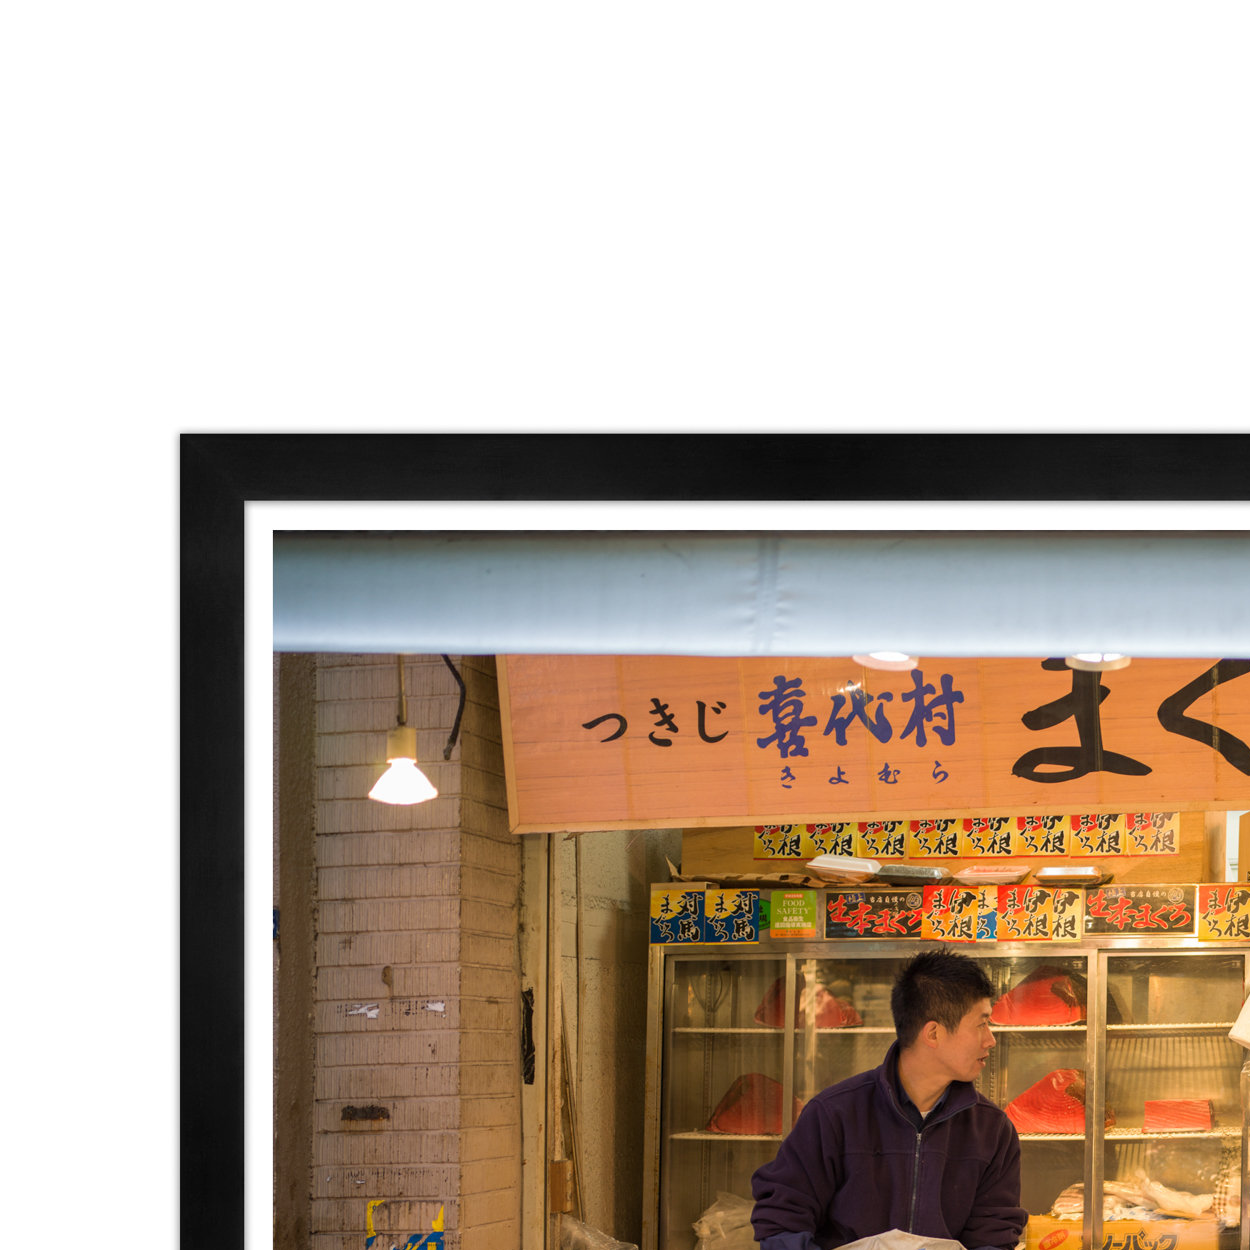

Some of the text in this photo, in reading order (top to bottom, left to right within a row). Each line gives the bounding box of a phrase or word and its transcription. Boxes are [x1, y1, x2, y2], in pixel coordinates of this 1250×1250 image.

[580, 697, 730, 748] つきじ
[756, 669, 965, 759] 喜代村
[779, 760, 950, 789] きよむら
[653, 892, 675, 943] まぐろ
[708, 892, 730, 943] まぐろ
[776, 907, 809, 915] SAFETY
[926, 888, 946, 937] まぐろ
[947, 888, 977, 939] 伊根
[1001, 888, 1021, 937] まぐろ
[1023, 887, 1051, 939] 伊根
[1086, 888, 1192, 931] 生本まぐろ
[1202, 888, 1222, 938] まぐろ
